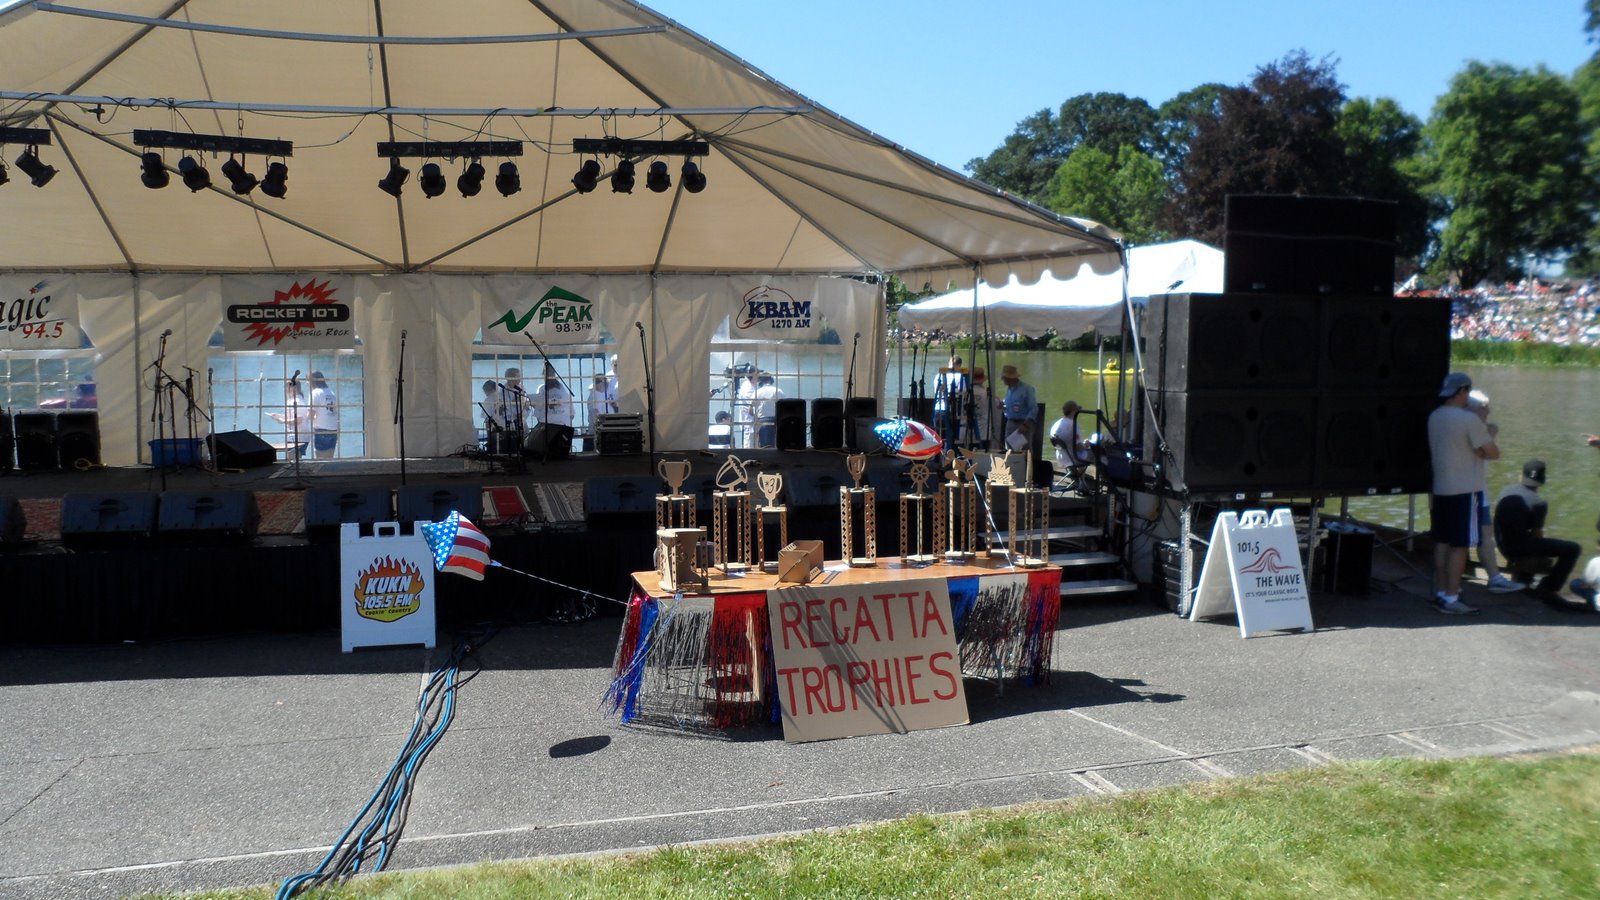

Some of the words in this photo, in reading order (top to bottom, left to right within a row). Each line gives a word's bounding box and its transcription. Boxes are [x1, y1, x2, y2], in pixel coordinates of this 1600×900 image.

[236, 308, 306, 319] ROCKET
[312, 308, 338, 318] 107
[539, 304, 593, 324] PEAK
[748, 301, 811, 318] KBAM
[22, 321, 65, 339] 94.5
[771, 320, 792, 328] 1270
[795, 319, 811, 328] AM
[1237, 541, 1260, 555] 101.5
[364, 575, 413, 595] KUKN
[1256, 576, 1273, 588] THE
[1275, 574, 1300, 586] WAVE
[363, 595, 393, 609] 105.5
[394, 593, 414, 607] FM
[778, 651, 958, 717] TROPHIES
